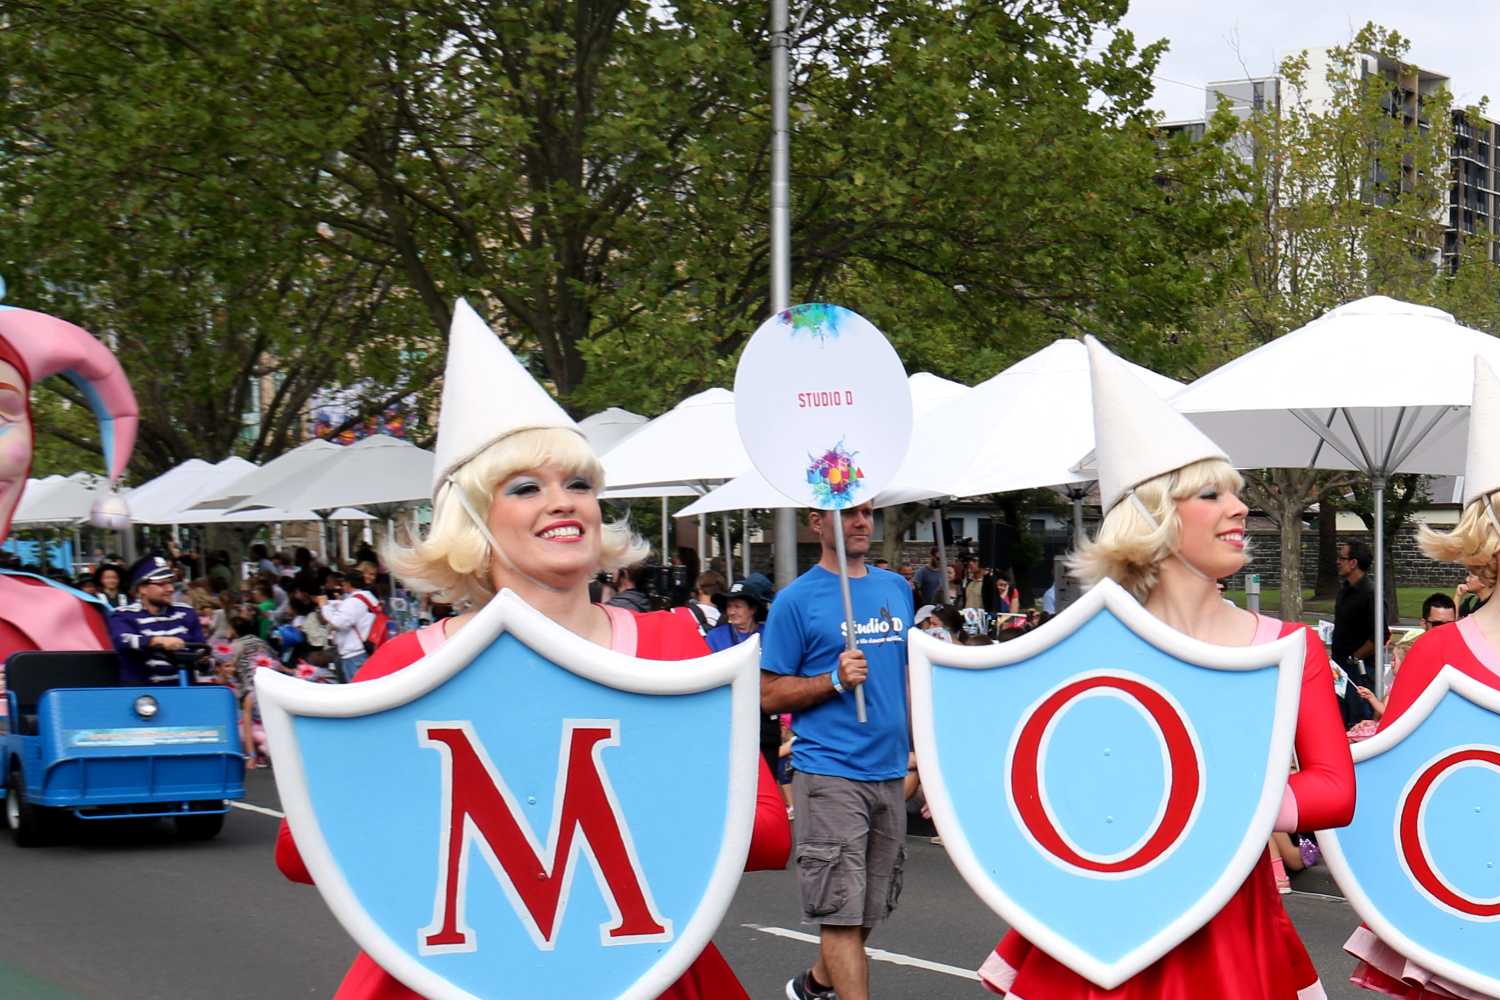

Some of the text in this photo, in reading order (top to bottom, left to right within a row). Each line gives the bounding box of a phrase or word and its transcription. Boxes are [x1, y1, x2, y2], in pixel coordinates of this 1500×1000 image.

[798, 390, 853, 407] STUDIO D
[891, 617, 903, 632] D
[1011, 675, 1200, 874] O
[425, 722, 674, 949] M
